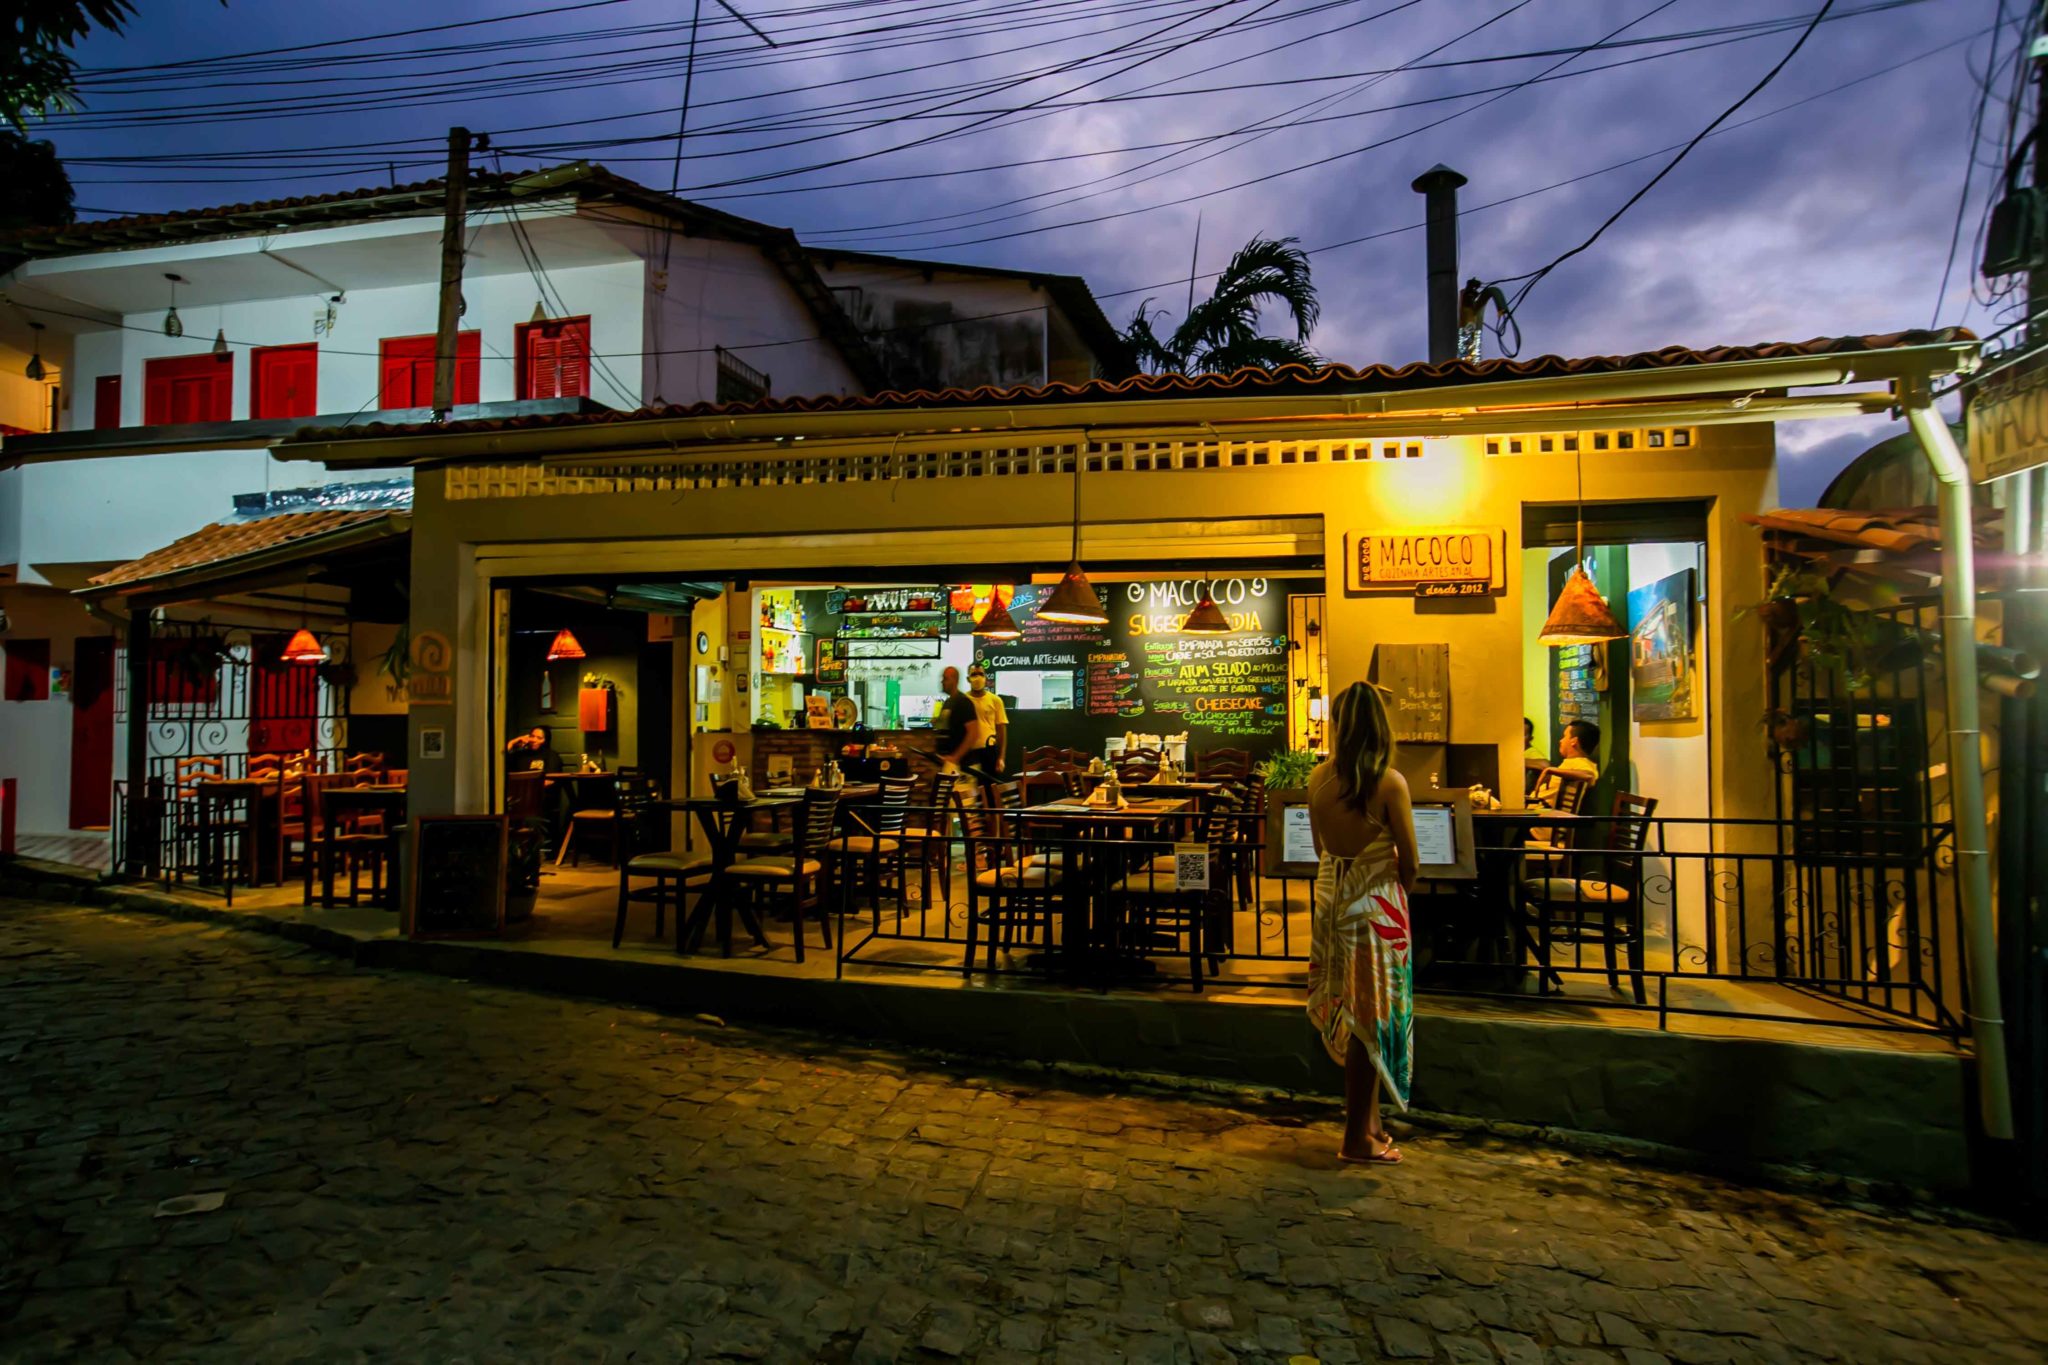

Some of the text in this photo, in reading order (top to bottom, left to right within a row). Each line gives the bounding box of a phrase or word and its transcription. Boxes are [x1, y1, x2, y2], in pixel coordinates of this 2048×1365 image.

[1380, 535, 1473, 566] MACOCO
[1379, 566, 1474, 578] COZINHA ARTESANAL
[1425, 583, 1483, 595] desde 2012
[1231, 611, 1262, 632] DIA
[1178, 639, 1223, 651] EMPANADA
[992, 654, 1078, 667] COZINHA ARTESANAL
[1201, 649, 1216, 660] SOL
[1179, 664, 1209, 678] ATUM
[1212, 662, 1251, 677] SELADO
[1261, 663, 1288, 673] MOLHO
[1195, 697, 1264, 711] CHEESECAKE
[1182, 711, 1254, 720] COM CHOCOLATE
